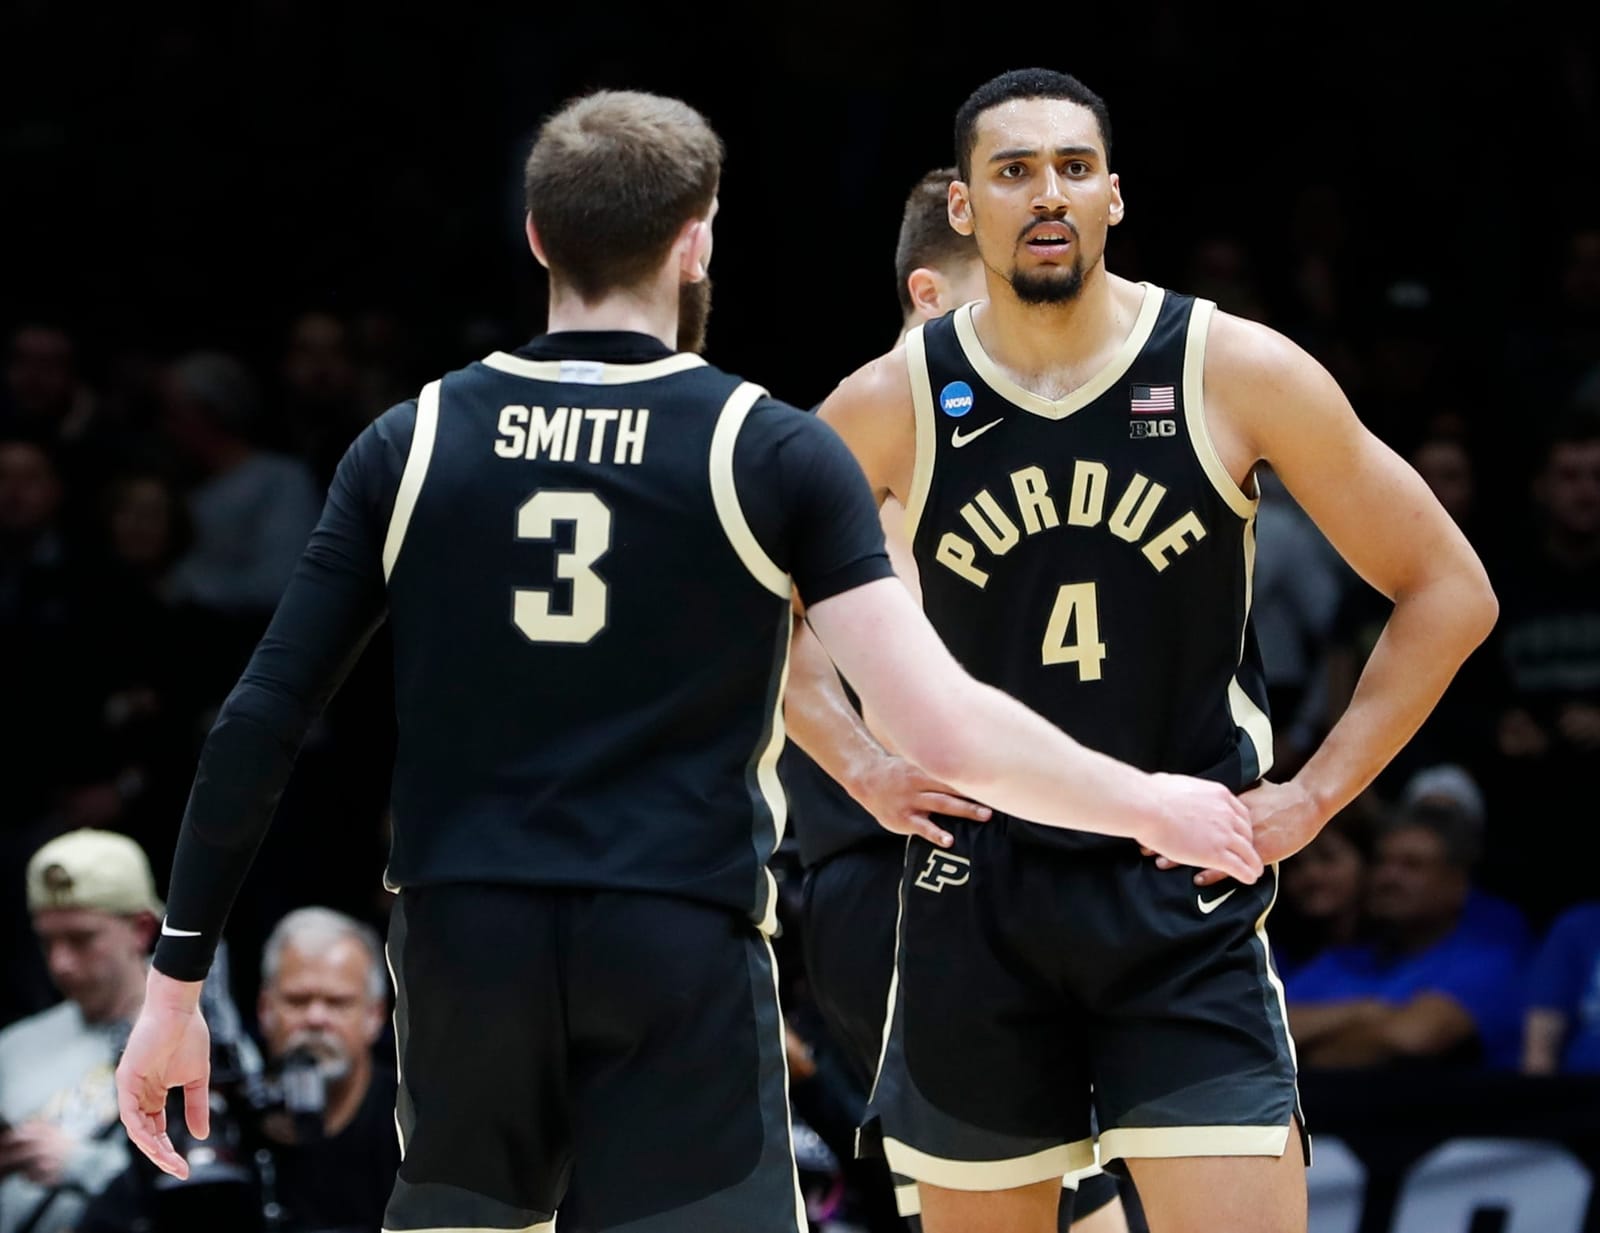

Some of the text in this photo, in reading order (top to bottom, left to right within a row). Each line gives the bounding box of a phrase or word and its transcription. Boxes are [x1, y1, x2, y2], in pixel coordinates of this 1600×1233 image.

[494, 404, 650, 465] SMITH
[944, 396, 972, 409] NCAA
[935, 459, 1207, 589] PURDUE
[513, 489, 612, 645] 3
[1041, 581, 1106, 682] 4
[914, 848, 971, 893] P
